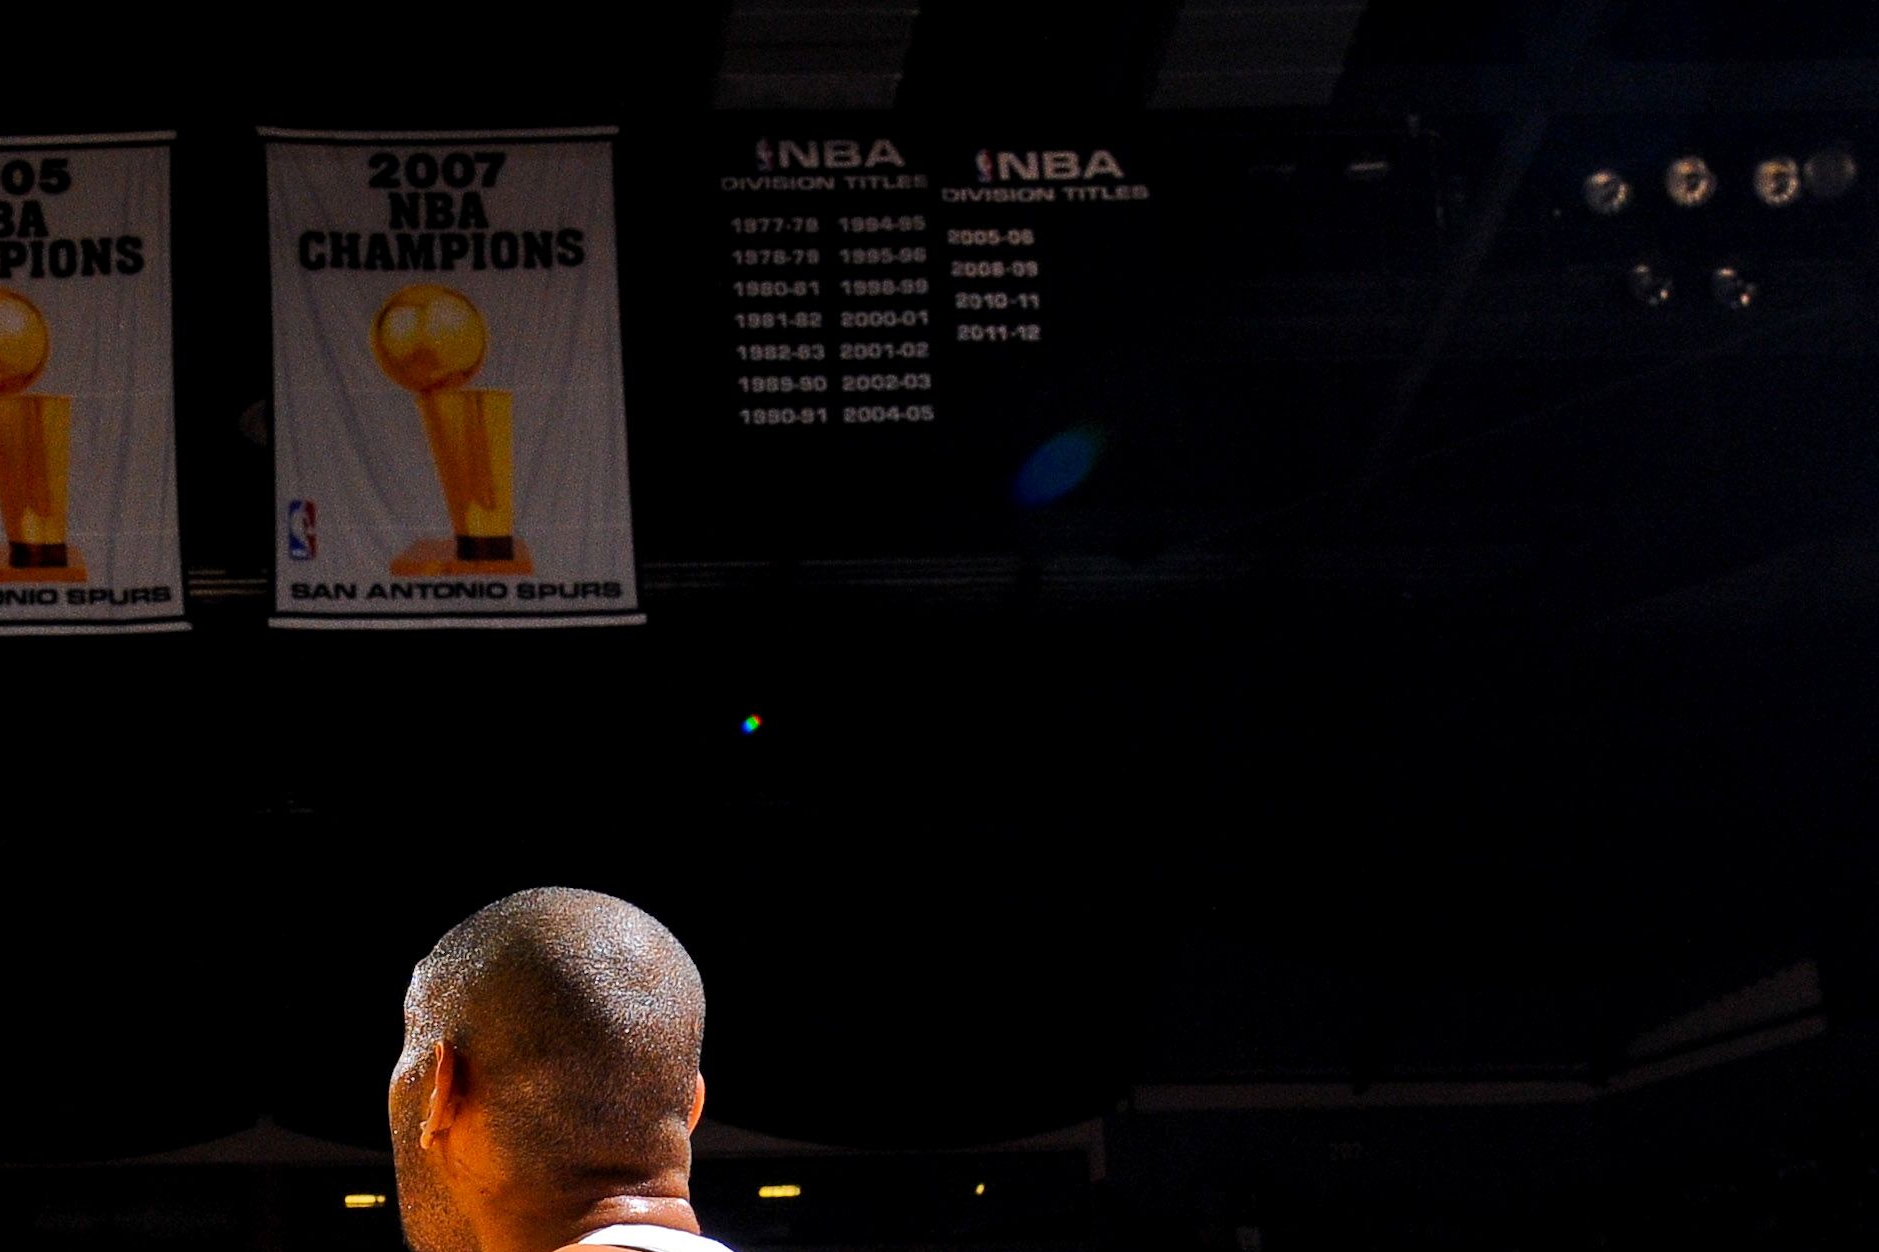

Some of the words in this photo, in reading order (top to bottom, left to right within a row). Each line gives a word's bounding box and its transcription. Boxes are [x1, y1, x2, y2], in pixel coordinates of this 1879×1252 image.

[778, 139, 905, 169] NBA
[368, 151, 507, 190] 2007
[997, 150, 1124, 181] NBA
[721, 175, 836, 191] DIVISION
[843, 174, 928, 190] TITLES
[942, 187, 1056, 203] DIVISION
[1062, 184, 1150, 201] TITLES
[388, 191, 490, 231] NBA
[298, 227, 585, 271] CHAMPIONS
[955, 291, 1040, 310] 2010-11
[840, 309, 929, 328] 2000-01
[957, 323, 1041, 342] 2011-12
[839, 341, 929, 360] 2001-02
[841, 372, 932, 392] 2002-03
[843, 404, 935, 423] 2004-05
[65, 586, 172, 606] SPURS
[290, 582, 357, 601] SAN
[366, 581, 508, 600] ANTONIO
[516, 581, 623, 601] SPURS
